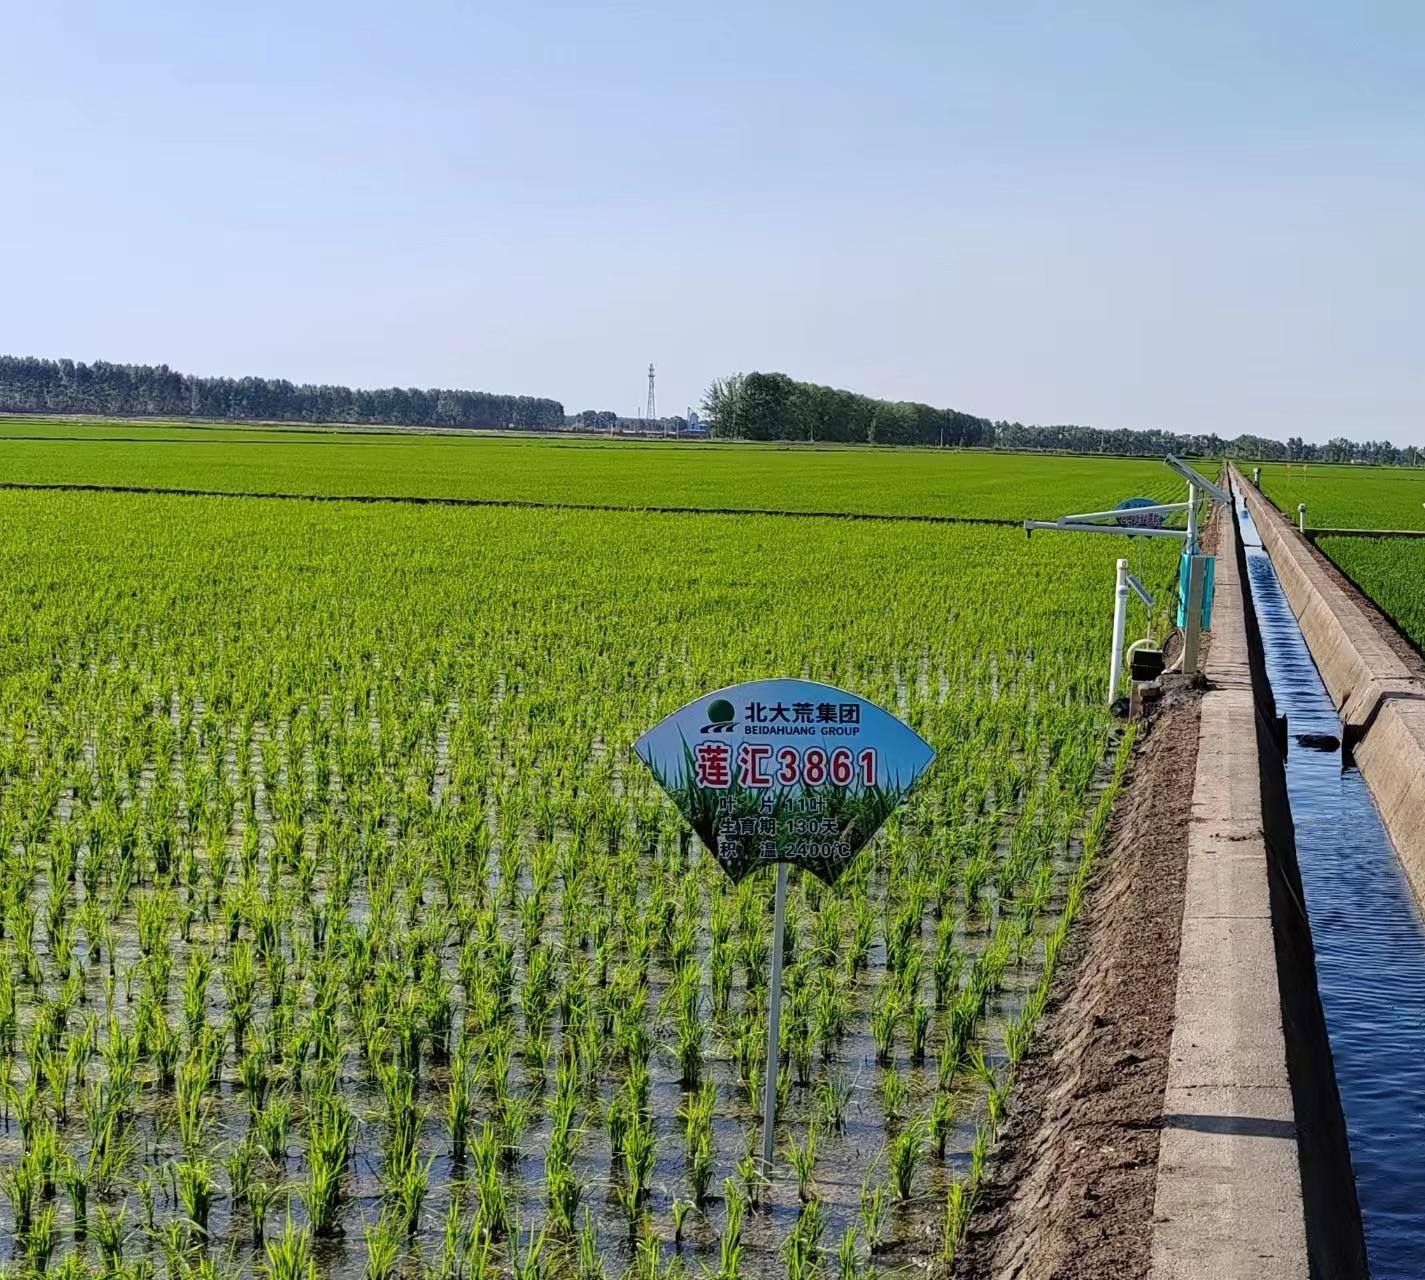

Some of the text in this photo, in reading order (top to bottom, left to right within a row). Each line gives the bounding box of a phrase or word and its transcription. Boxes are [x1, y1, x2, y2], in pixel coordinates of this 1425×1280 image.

[745, 702, 860, 724] 北大荒集团
[744, 726, 860, 736] BEIDAHUANG GROUP
[696, 743, 878, 787] 莲汇3861
[787, 817, 839, 835] 130天
